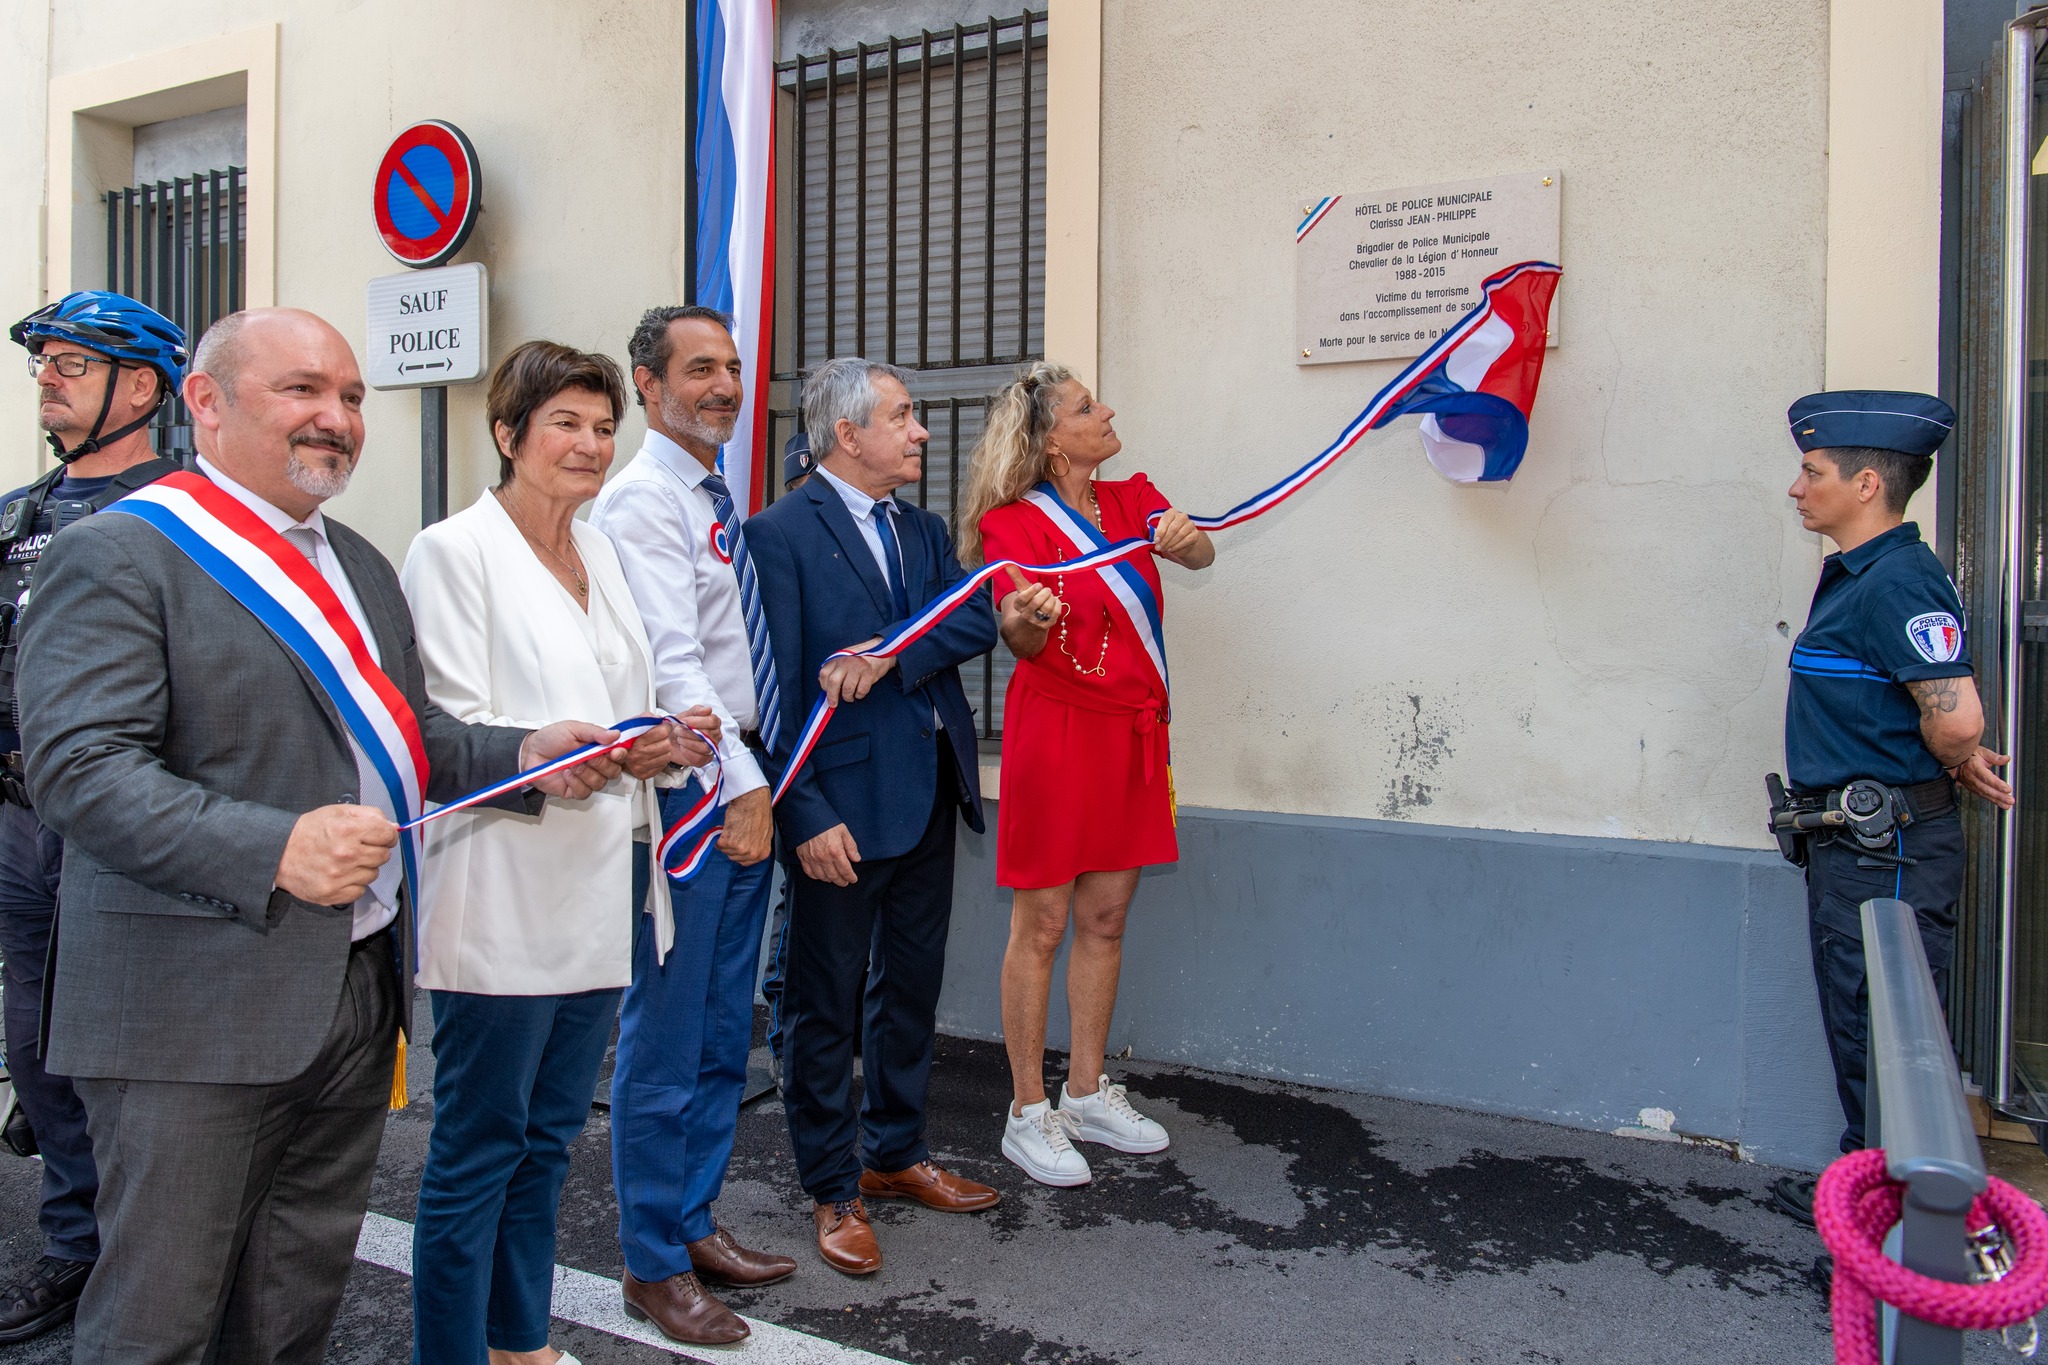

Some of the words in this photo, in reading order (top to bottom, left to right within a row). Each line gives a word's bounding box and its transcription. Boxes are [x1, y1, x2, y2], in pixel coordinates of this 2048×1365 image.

[1355, 203, 1382, 216] HÔTEL
[1386, 202, 1398, 212] DE
[1402, 198, 1433, 211] POLICE
[1437, 191, 1492, 206] MUNICIPALE
[1370, 218, 1403, 230] Clarissa
[1356, 242, 1394, 255] Brigadier
[1398, 240, 1408, 250] de
[1412, 237, 1438, 248] Police
[1442, 232, 1490, 245] Municipale
[1349, 258, 1388, 270] Chevalier
[1392, 256, 1402, 266] de
[1406, 254, 1414, 264] la
[1418, 252, 1446, 264] Légion
[400, 290, 448, 315] SAUF
[1376, 292, 1406, 304] Victime
[1411, 290, 1422, 300] du
[1426, 286, 1470, 299] terrorisme
[1340, 312, 1360, 322] dans
[1364, 304, 1442, 320] l'accomplissement
[1446, 302, 1456, 312] de
[1460, 302, 1476, 311] son
[390, 328, 460, 354] POLICE
[1320, 337, 1342, 348] Morte
[1346, 336, 1365, 348] pour
[1368, 334, 1376, 344] le
[1380, 332, 1410, 342] service
[1414, 330, 1425, 340] de
[1429, 329, 1437, 338] la
[1919, 618, 1948, 626] POLICE
